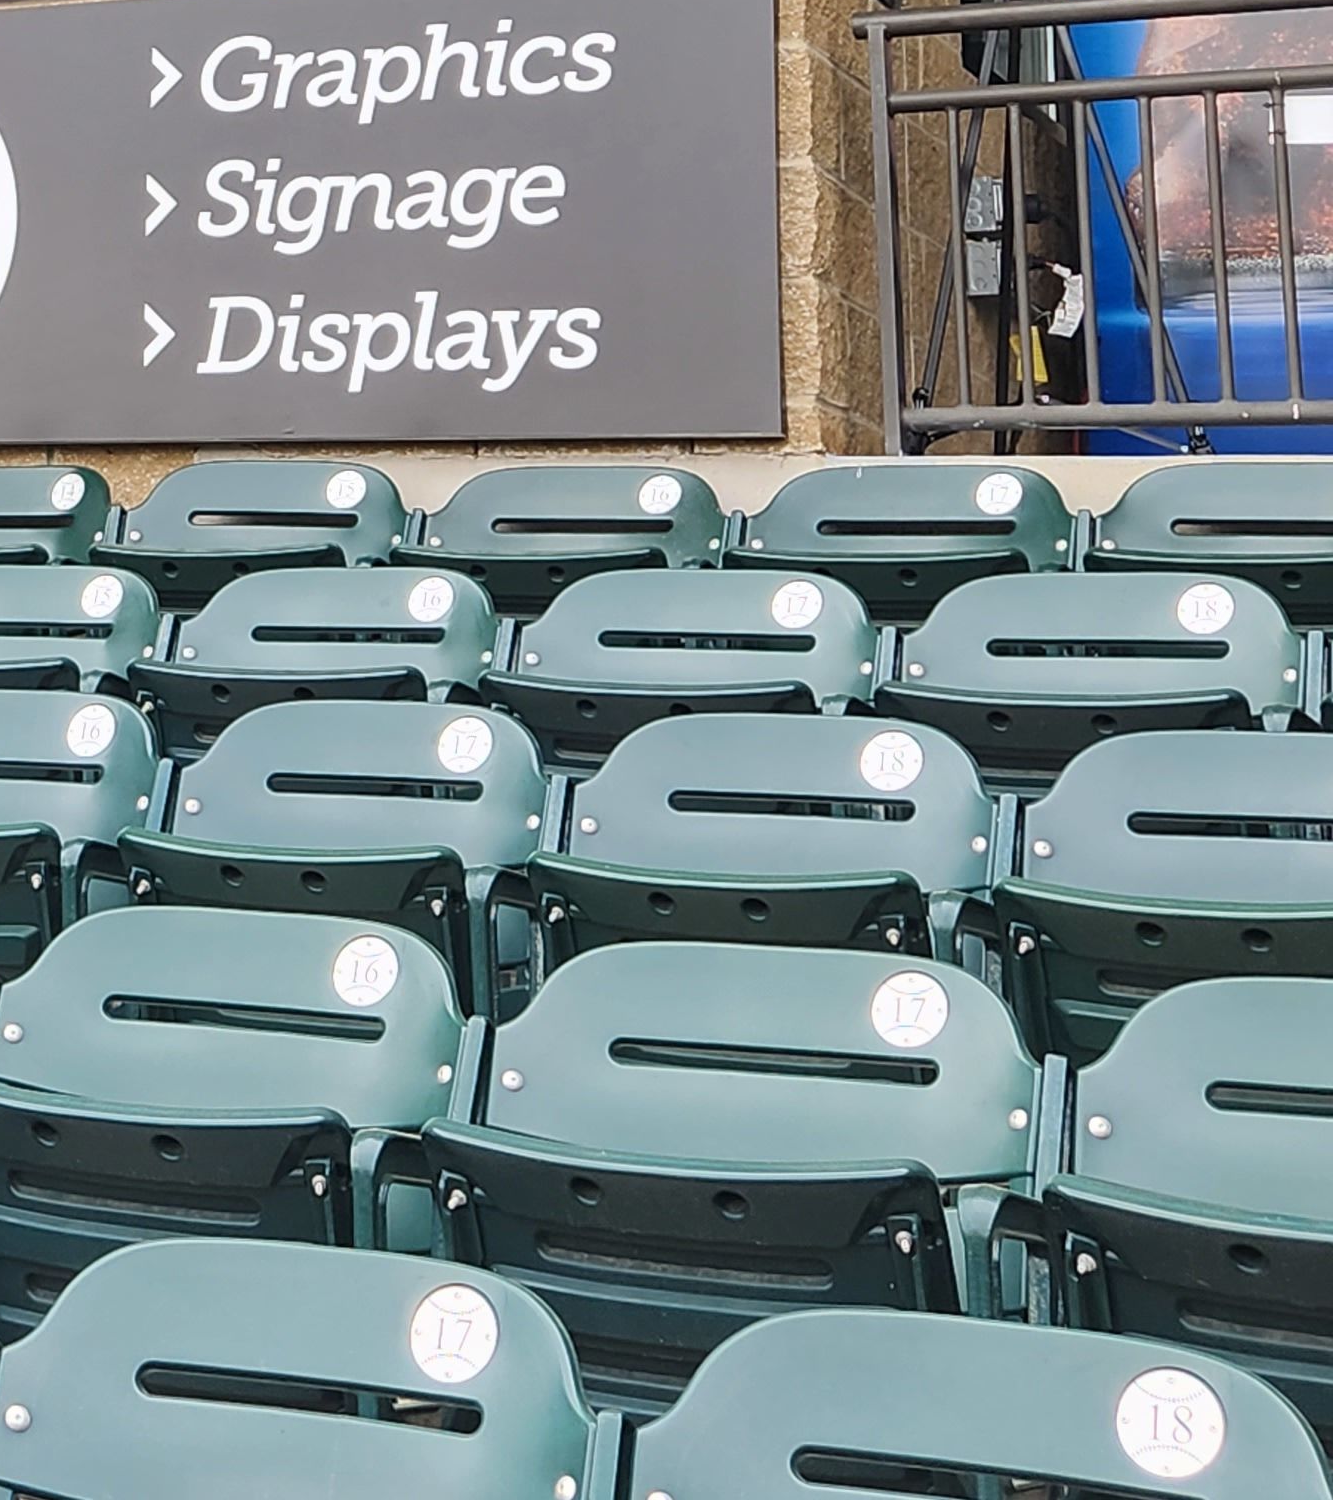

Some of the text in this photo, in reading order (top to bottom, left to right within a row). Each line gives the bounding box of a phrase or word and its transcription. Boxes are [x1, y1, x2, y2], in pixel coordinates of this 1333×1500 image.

[199, 18, 617, 125] Graphics
[197, 157, 567, 256] Signage
[195, 290, 602, 393] Displays
[80, 722, 101, 741] 16
[454, 735, 478, 755] 17
[878, 751, 905, 772] 18
[351, 959, 379, 984] 16
[894, 996, 925, 1023] 17
[435, 1317, 473, 1351] 17
[1149, 1403, 1195, 1444] 18
